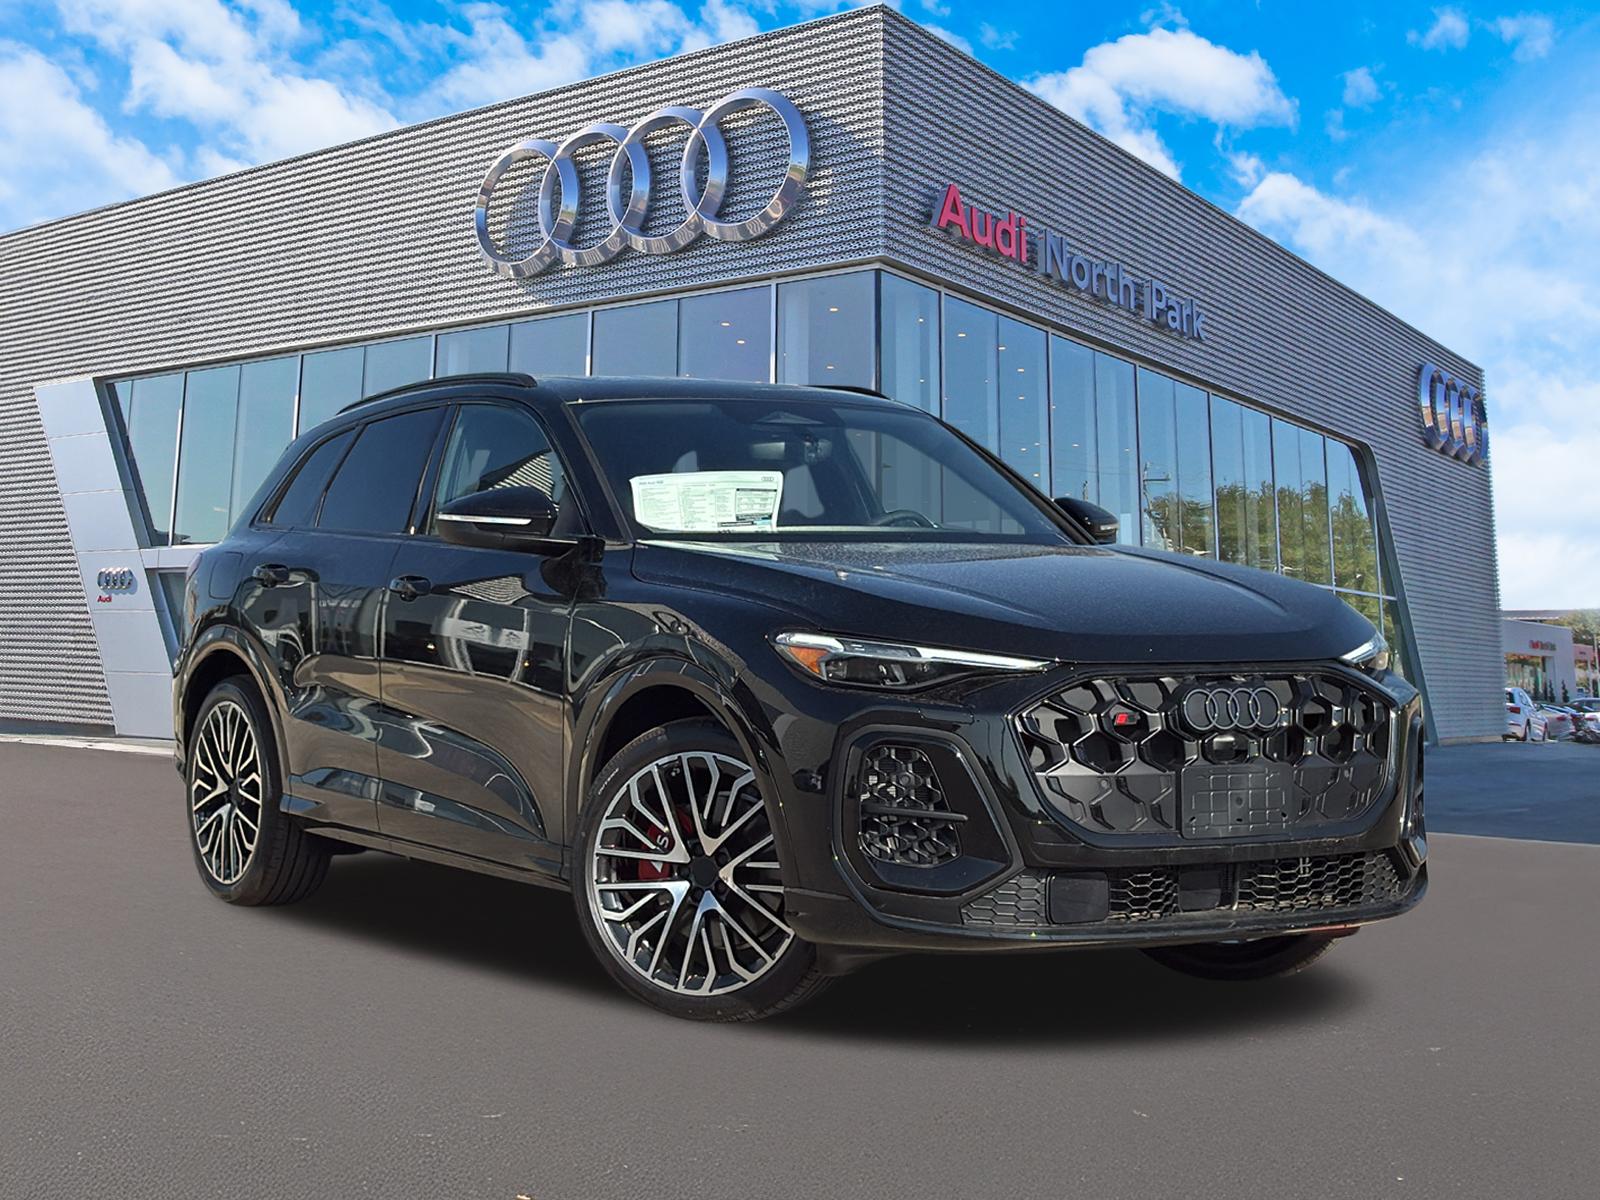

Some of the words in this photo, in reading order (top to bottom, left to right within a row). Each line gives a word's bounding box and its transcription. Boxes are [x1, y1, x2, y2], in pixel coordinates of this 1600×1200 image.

[931, 183, 1028, 263] Audi
[1040, 229, 1136, 310] North
[1146, 279, 1206, 340] Park
